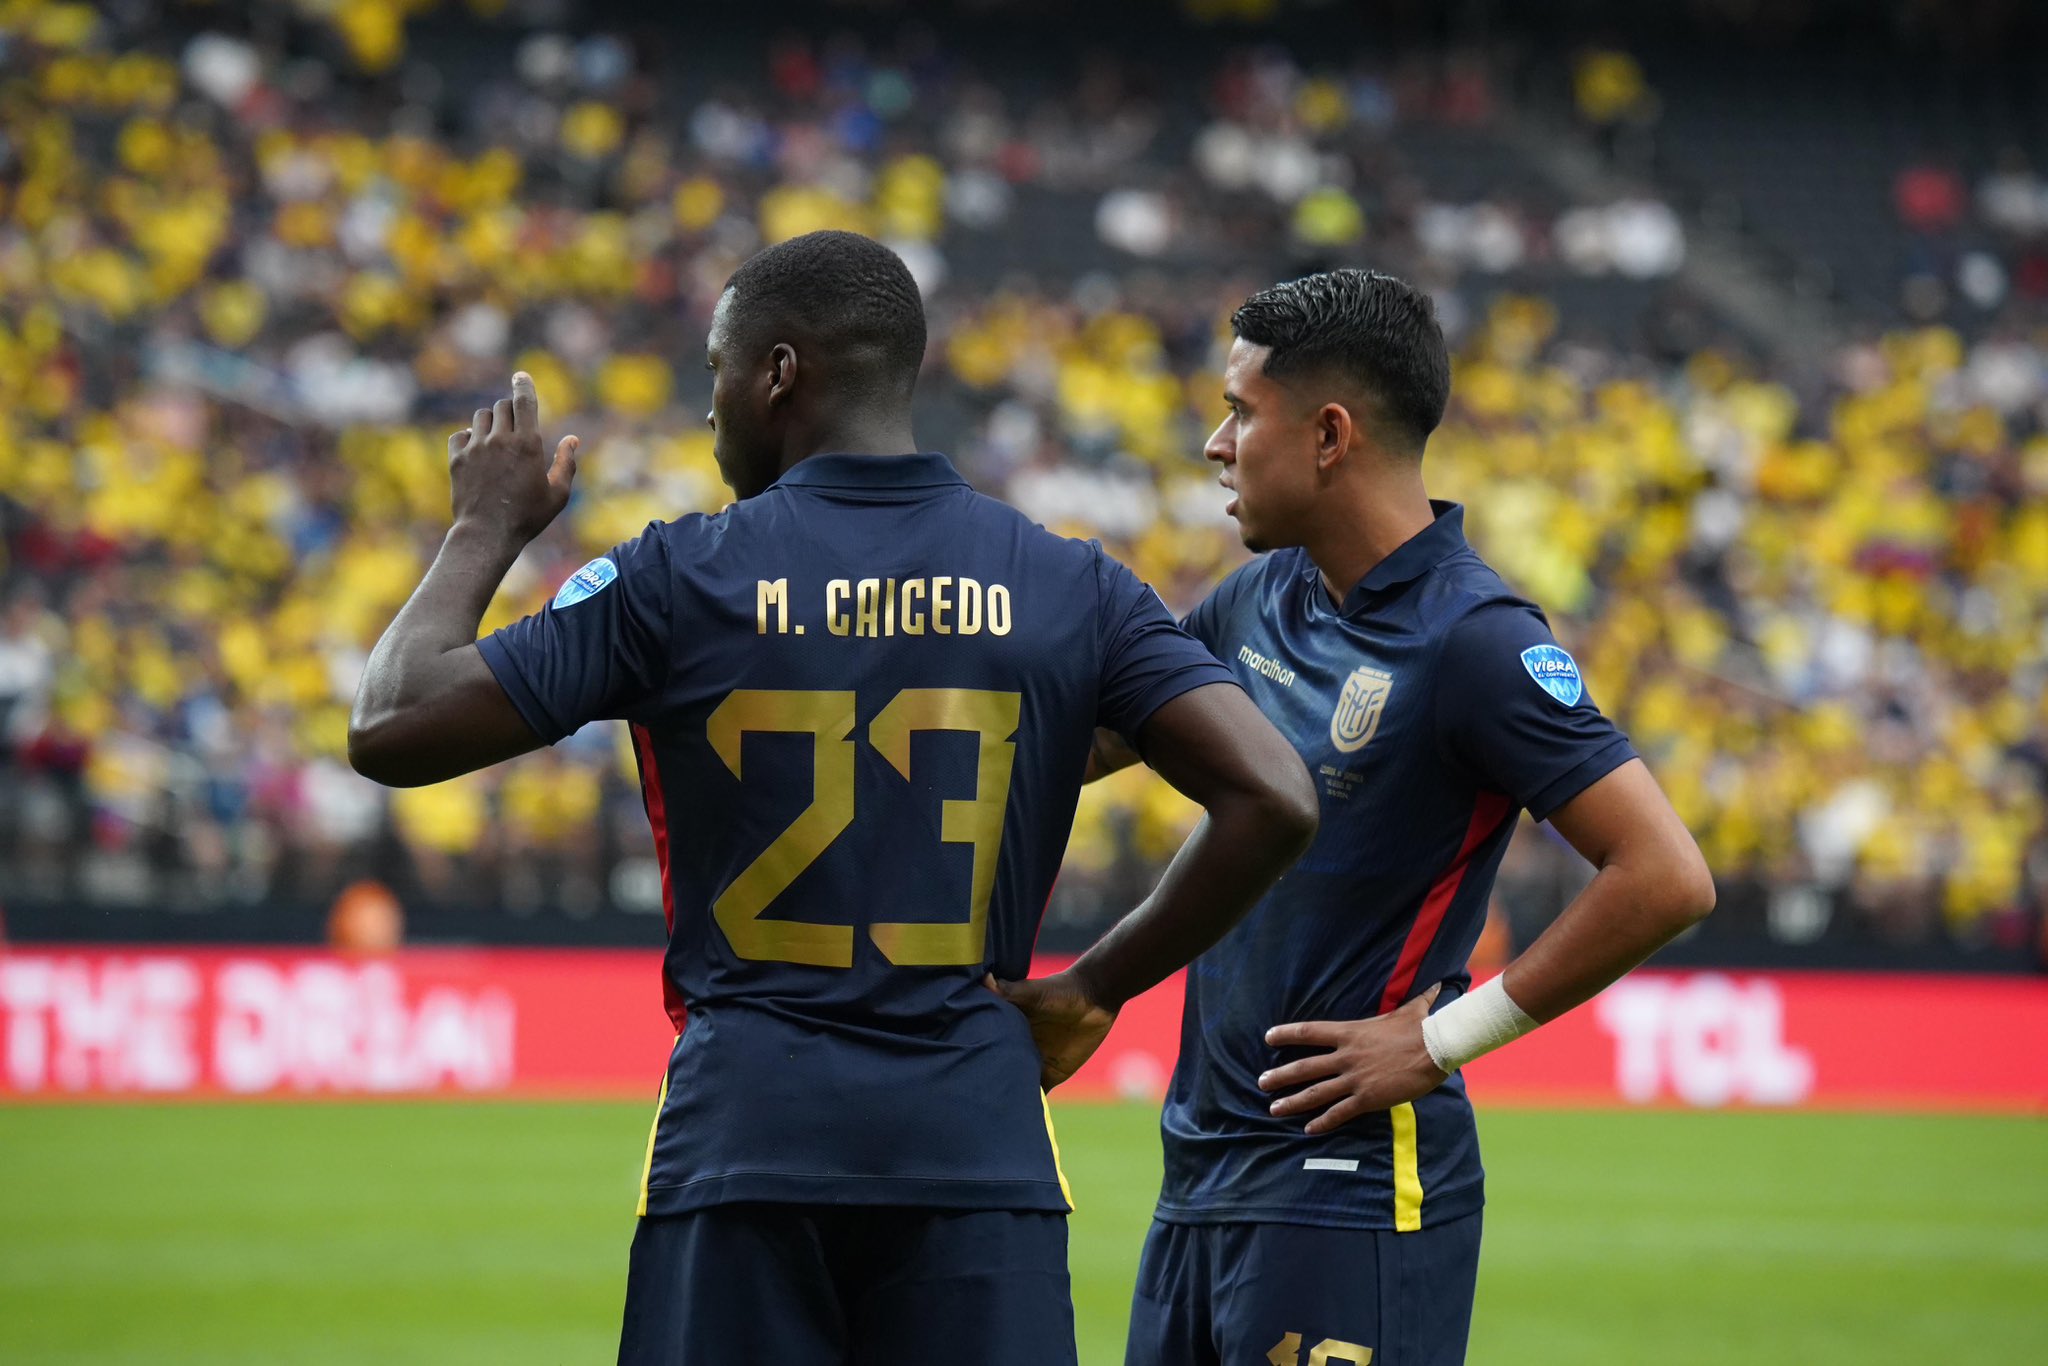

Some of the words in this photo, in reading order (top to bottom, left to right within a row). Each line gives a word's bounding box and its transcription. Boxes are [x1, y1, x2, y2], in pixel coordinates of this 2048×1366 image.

[757, 577, 805, 635] M.
[826, 576, 1012, 637] CAICEDO
[1237, 645, 1295, 687] marathon
[1533, 660, 1574, 673] VIBRA
[706, 688, 1022, 968] 23
[0, 958, 199, 1092] THE
[1596, 973, 1816, 1106] TCL
